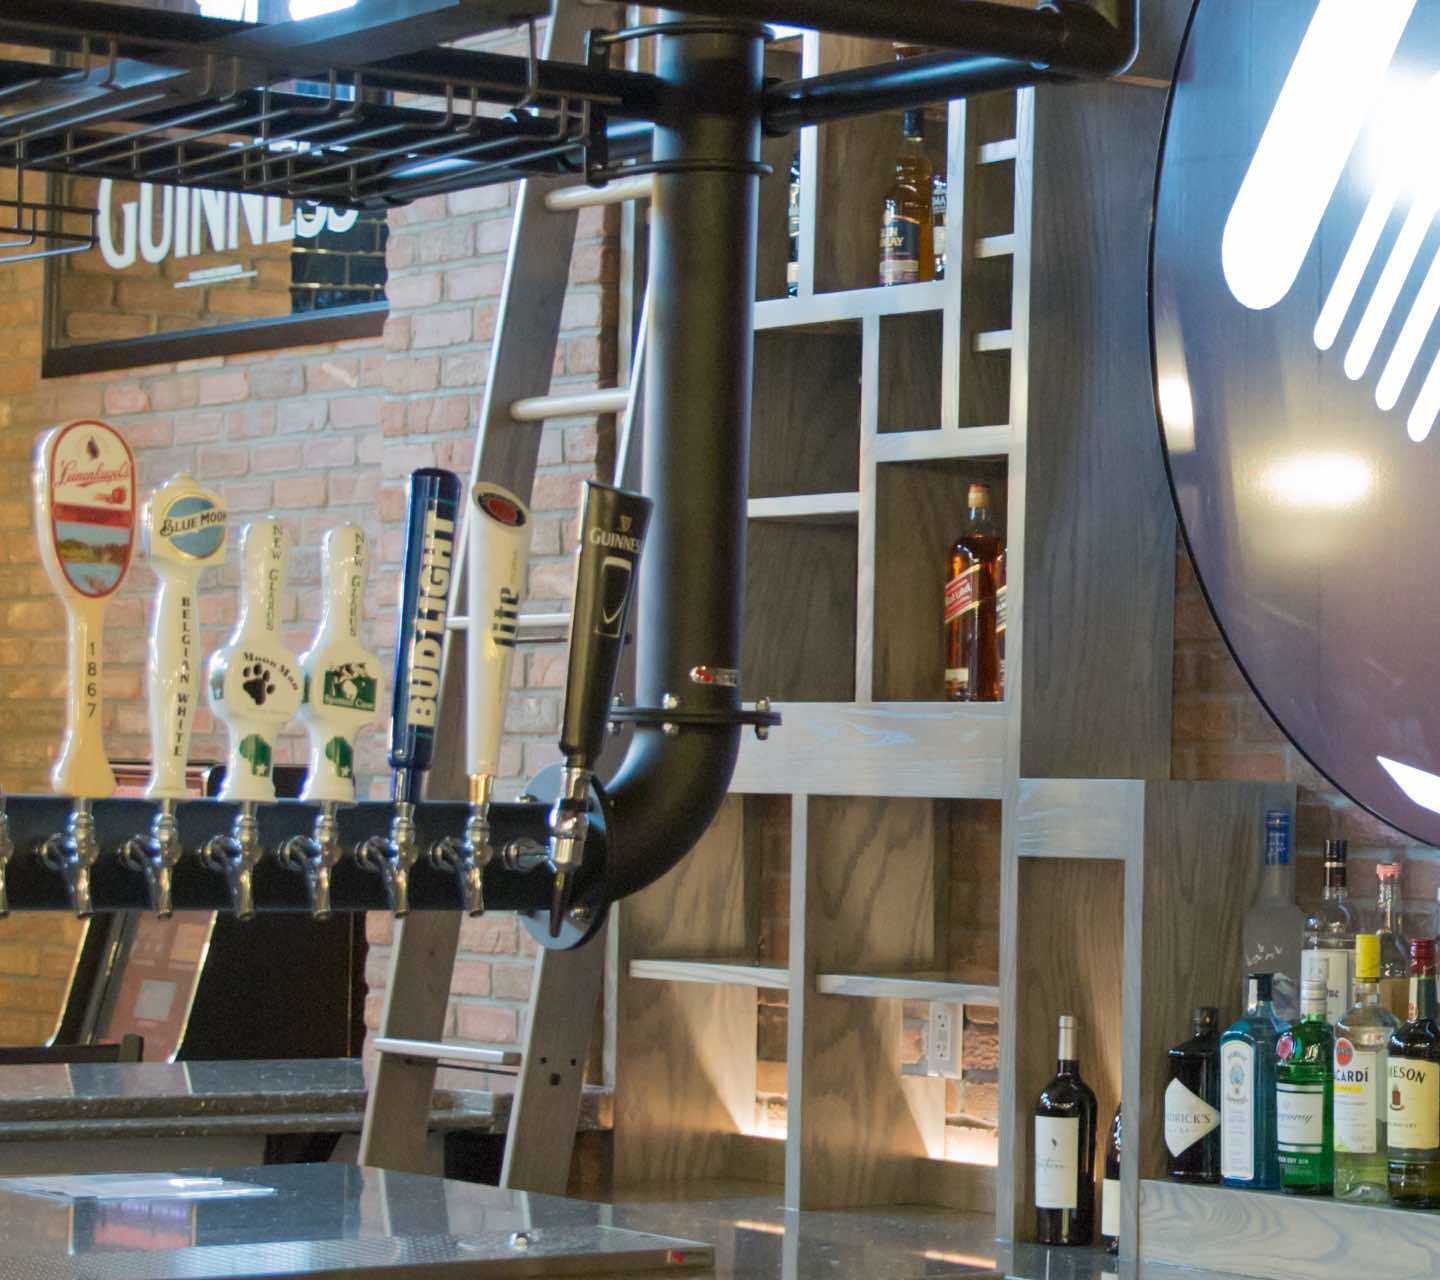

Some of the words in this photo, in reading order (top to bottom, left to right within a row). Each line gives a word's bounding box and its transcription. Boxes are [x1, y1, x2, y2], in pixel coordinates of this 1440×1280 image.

[160, 517, 196, 536] BLUE
[271, 524, 283, 561] NEW
[353, 532, 365, 569] NEW
[589, 527, 641, 552] GUINNES
[414, 510, 455, 635] LIGHT
[179, 596, 192, 684] BELGIAN
[87, 642, 97, 718] 1867
[407, 637, 441, 727] BUD
[173, 692, 190, 757] WHITE
[1334, 1067, 1369, 1083] CARDÍ
